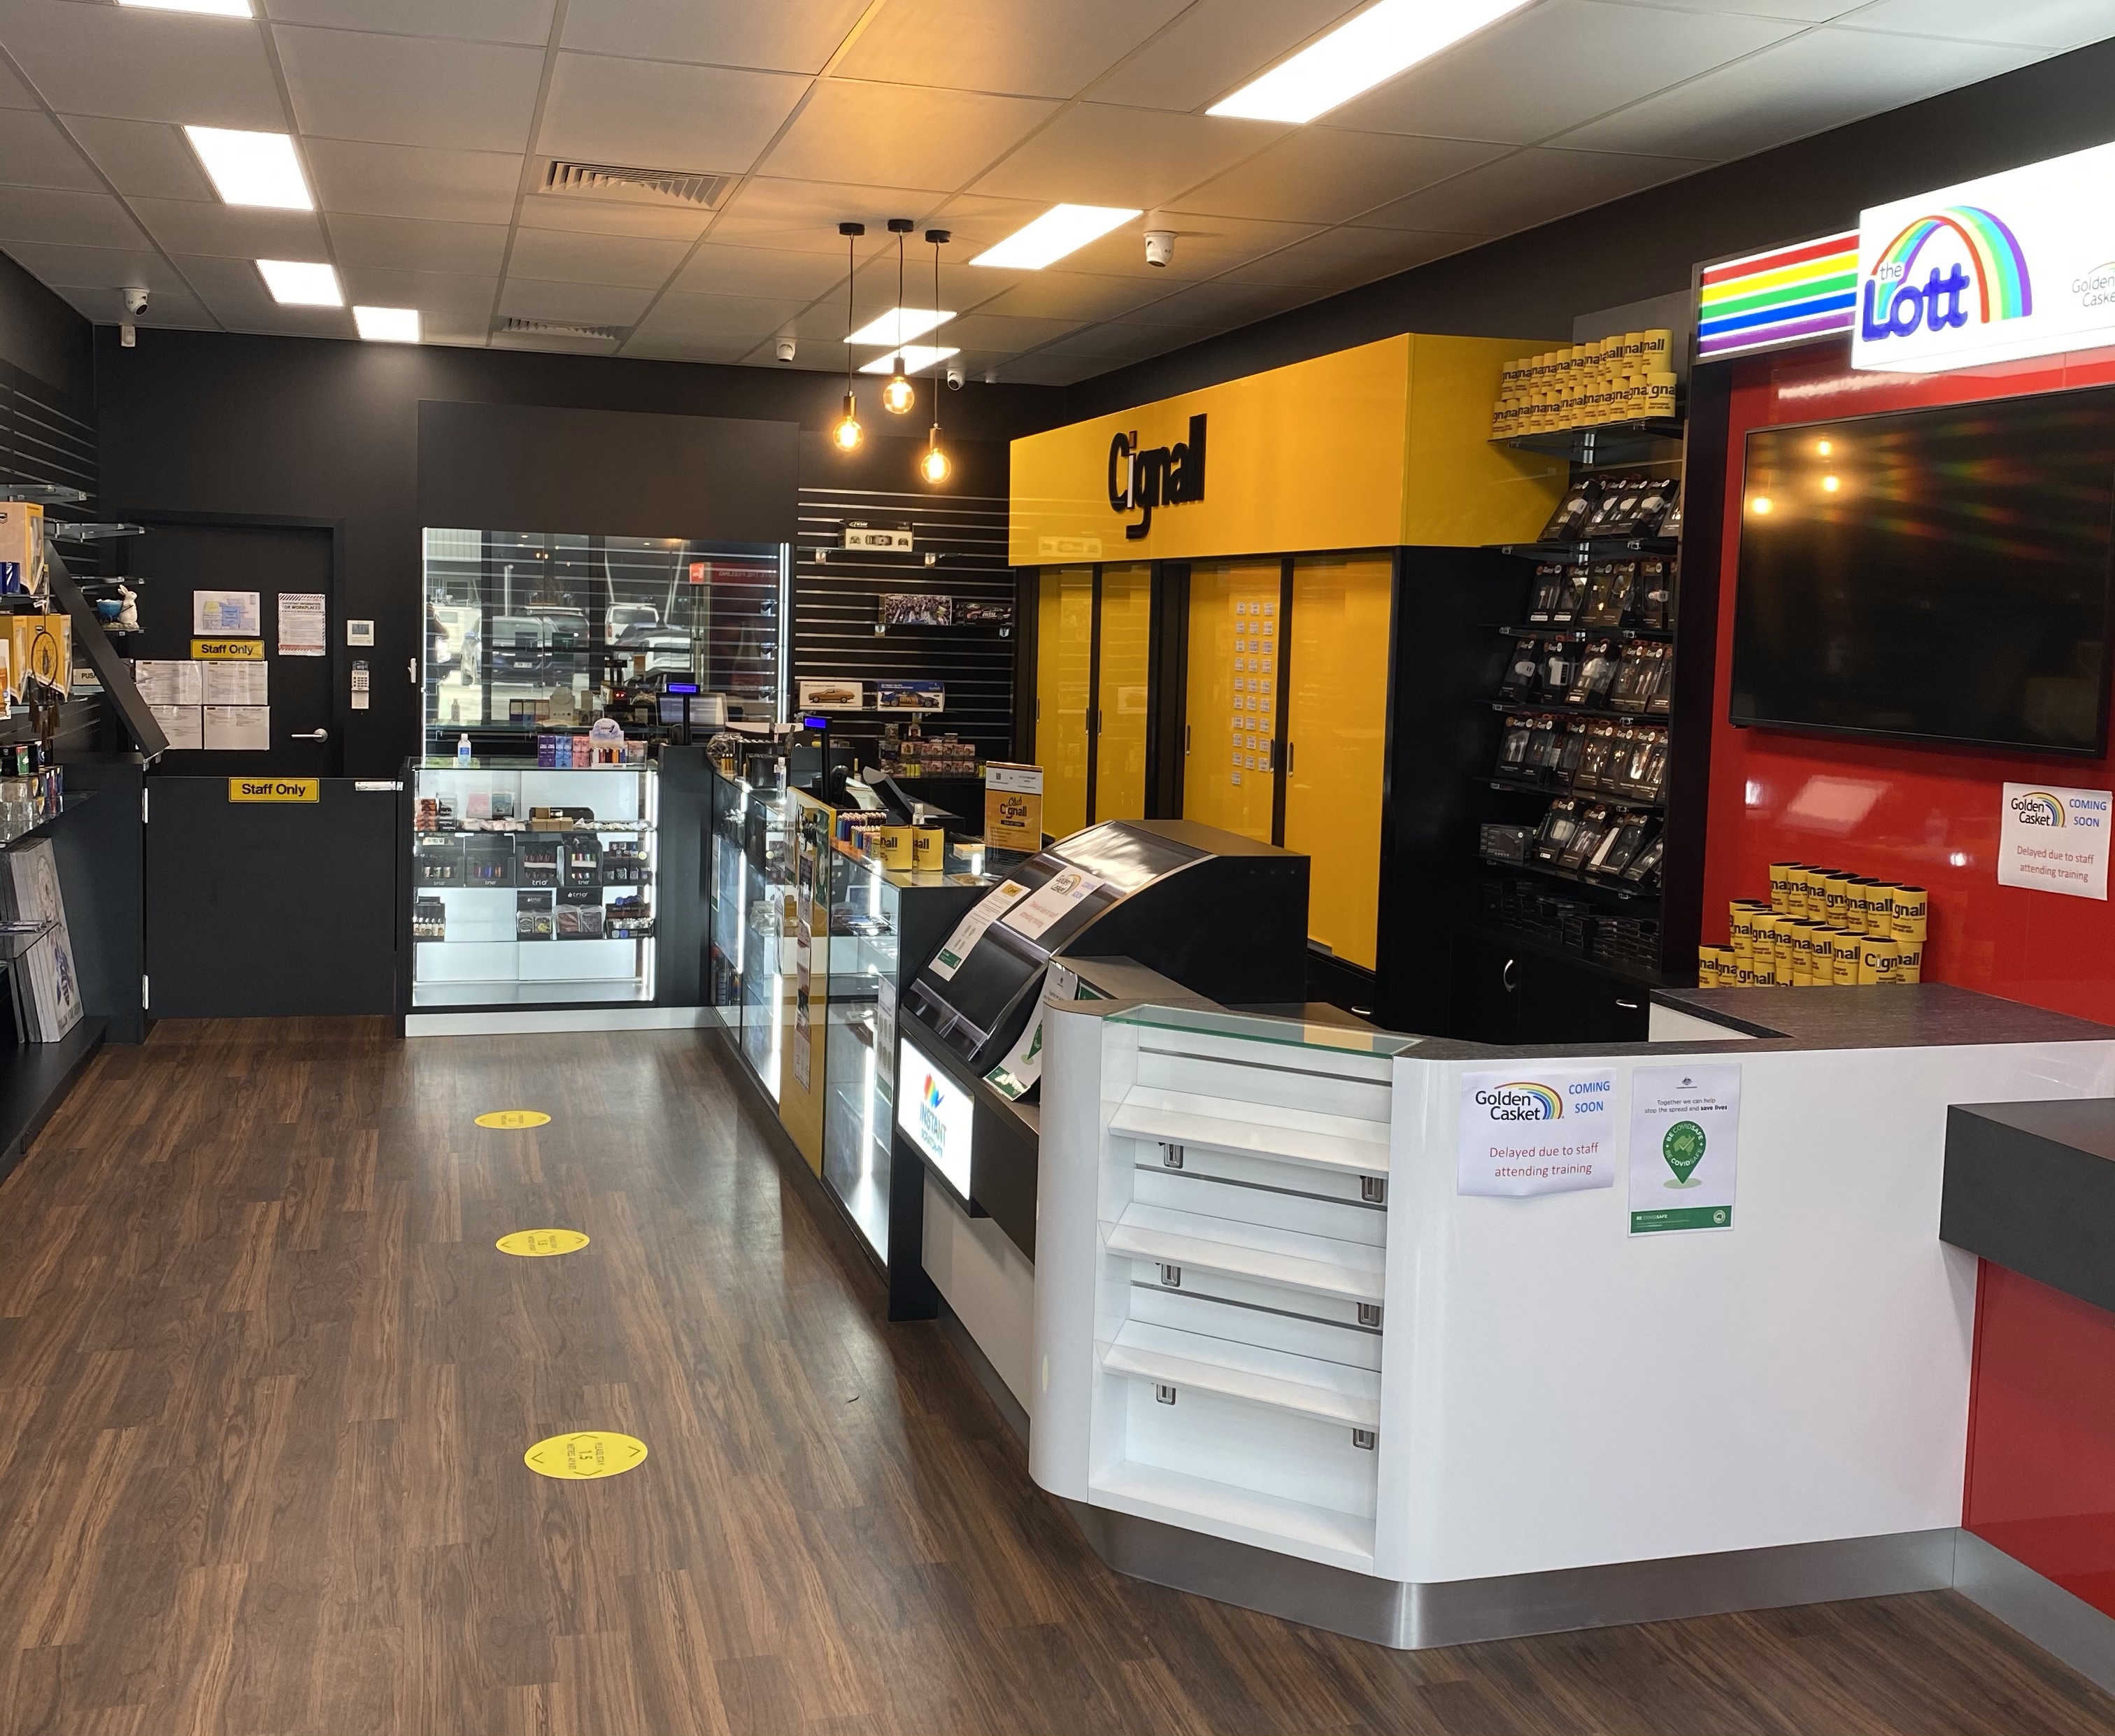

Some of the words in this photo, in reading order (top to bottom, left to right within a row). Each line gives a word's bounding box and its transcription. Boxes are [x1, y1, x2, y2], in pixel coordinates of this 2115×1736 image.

[1880, 262, 1902, 280] the
[2072, 276, 2114, 293] Golden
[1862, 263, 1970, 342] Lott
[1108, 413, 1208, 540] Cignall
[201, 643, 227, 654] Staff
[229, 645, 253, 655] Only
[241, 783, 273, 795] Staff
[276, 783, 306, 797] Only
[1000, 803, 1027, 818] Cignall
[1009, 796, 1023, 807] Club
[2011, 798, 2044, 813] Golden
[2070, 799, 2107, 811] COMING
[2019, 811, 2051, 827] Casket
[2074, 816, 2100, 827] SOON
[2017, 846, 2046, 859] Delayed
[2049, 850, 2063, 860] due
[2065, 853, 2074, 862] to
[2076, 855, 2095, 865] staff
[2020, 865, 2056, 878] attending
[2058, 869, 2088, 883] training
[1476, 1091, 1531, 1107] Golden
[1569, 1081, 1610, 1095] COMING
[1490, 1107, 1540, 1120] Casket
[1575, 1101, 1604, 1114] SOON
[919, 1101, 947, 1147] INSTANT
[1666, 1132, 1674, 1141] BE
[1673, 1123, 1704, 1140] COVIDSAFE
[1490, 1146, 1536, 1160] Delayed
[1539, 1146, 1559, 1157] due
[1562, 1146, 1574, 1155] to
[1576, 1141, 1599, 1154] staff
[1666, 1150, 1673, 1159] BE
[1671, 1148, 1703, 1167] COVIDSAFE
[1495, 1166, 1548, 1178] attending
[1551, 1164, 1592, 1175] training
[579, 1451, 593, 1460] 1.5
